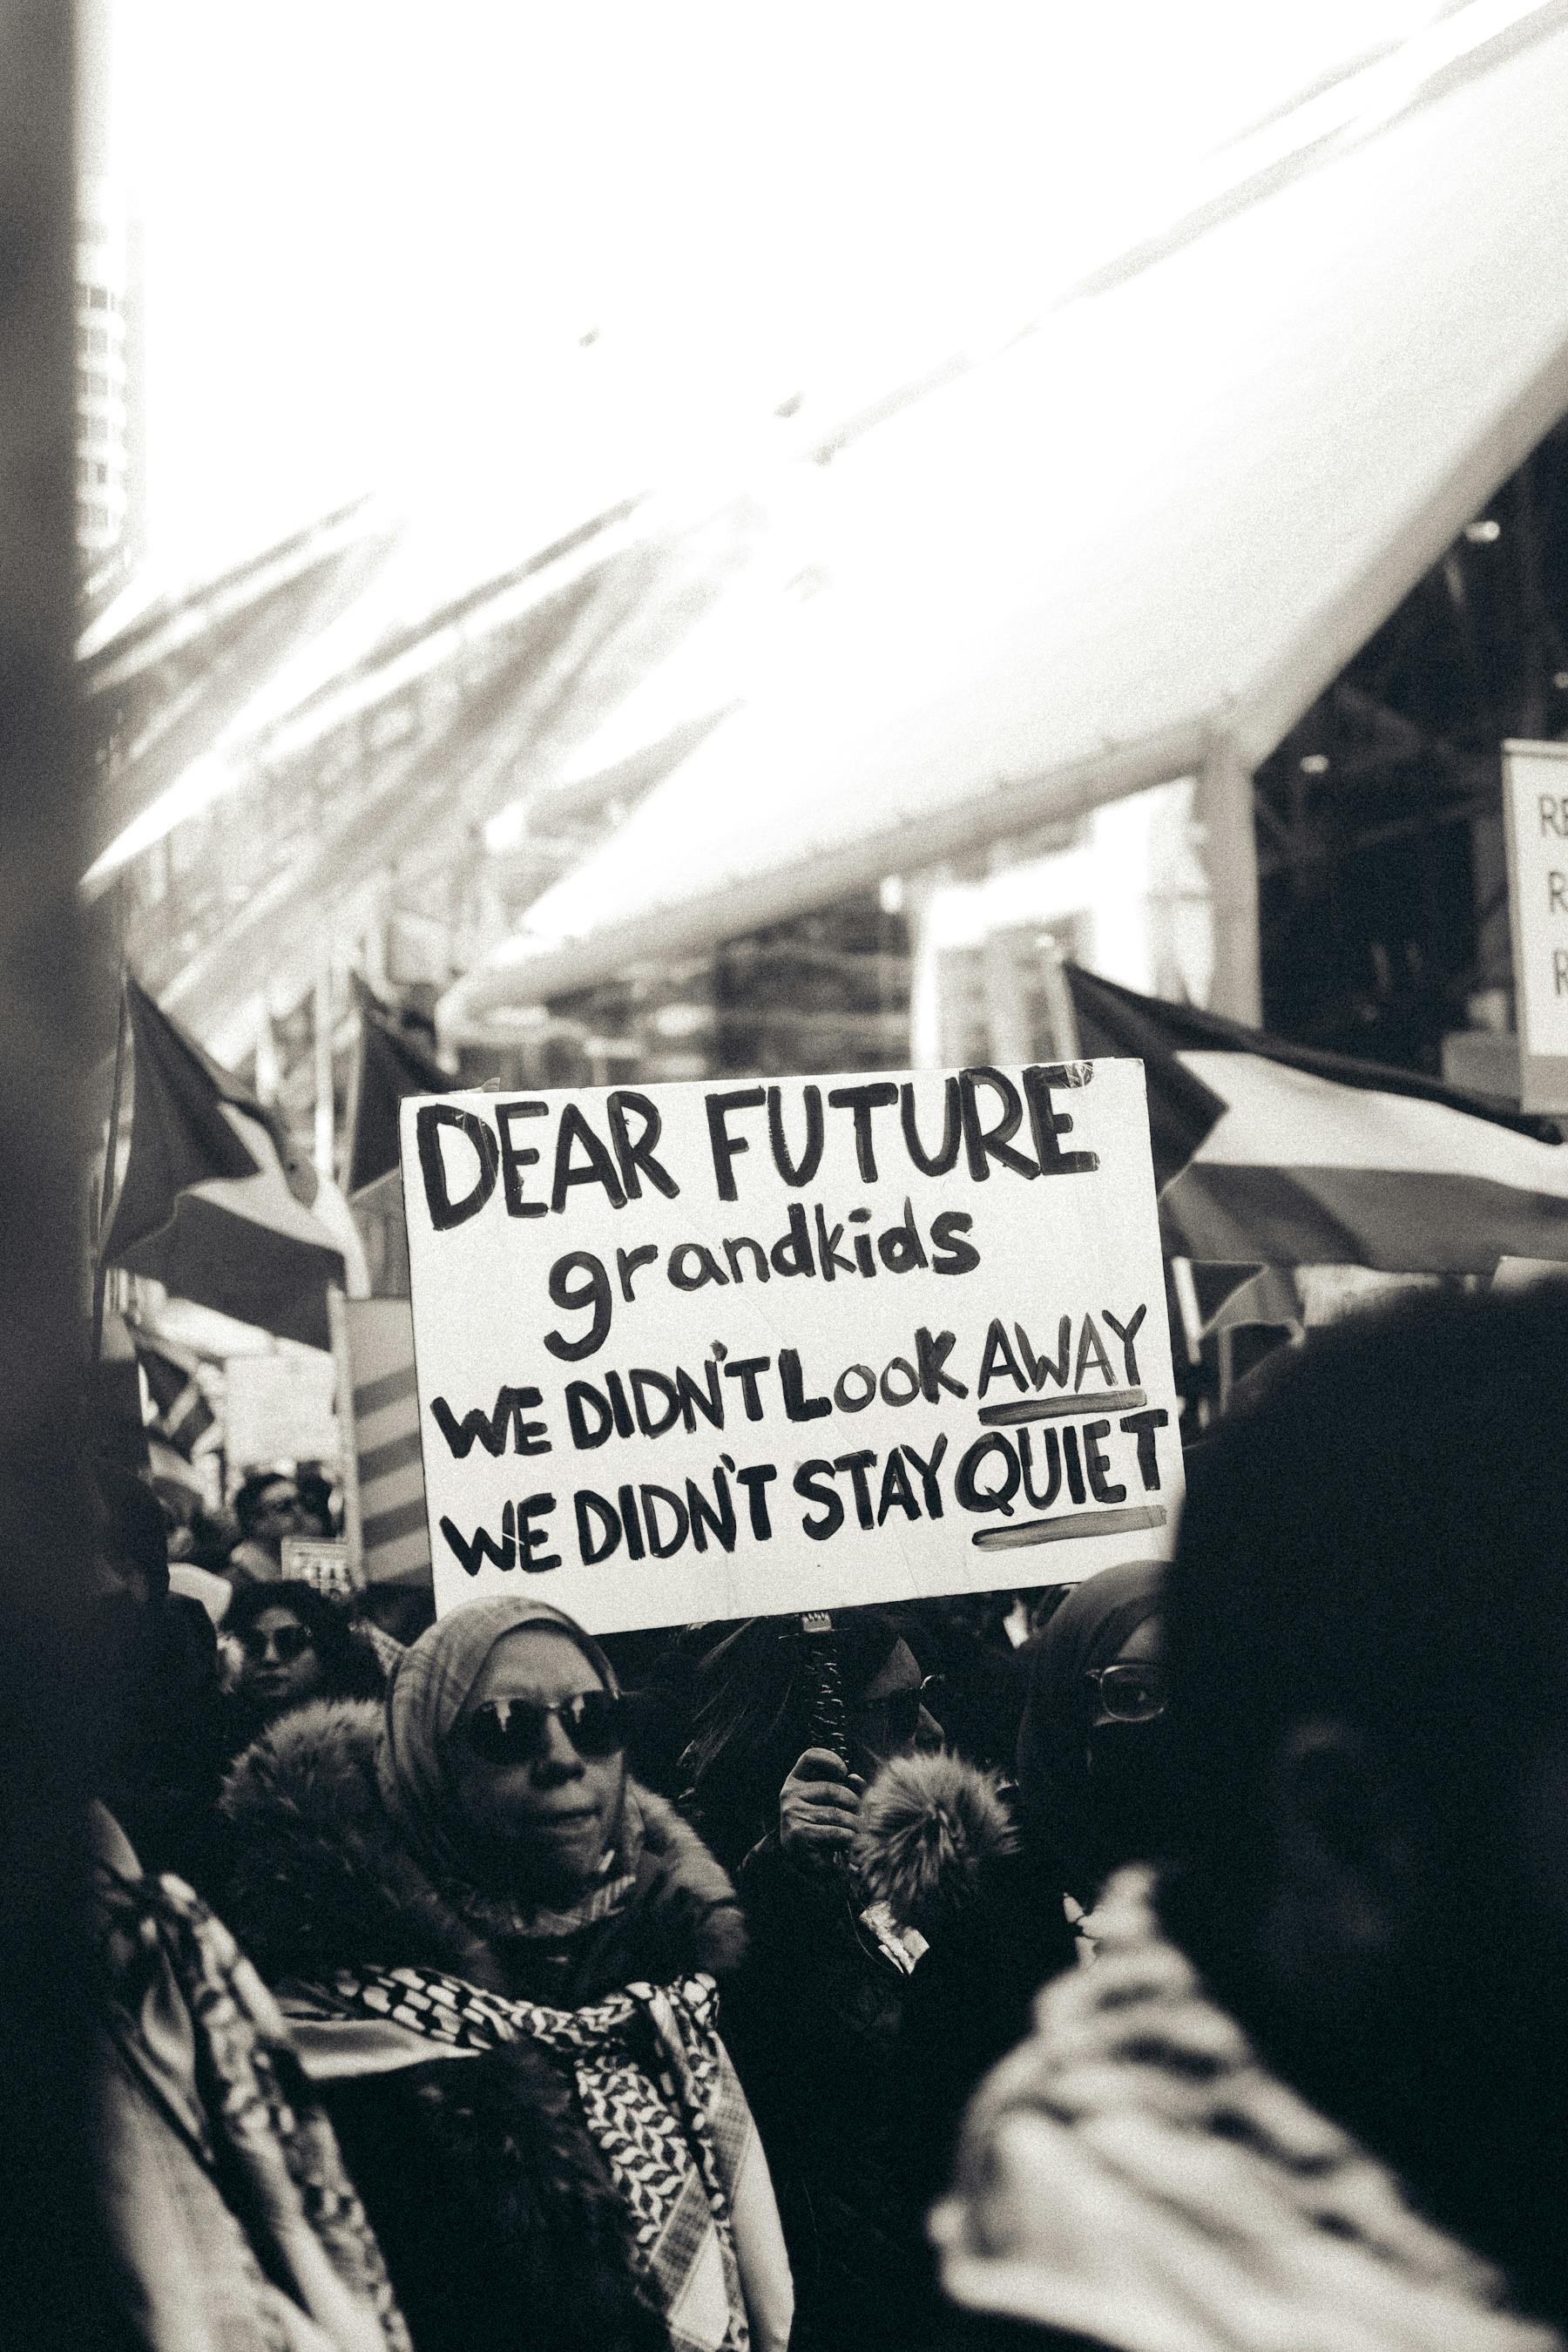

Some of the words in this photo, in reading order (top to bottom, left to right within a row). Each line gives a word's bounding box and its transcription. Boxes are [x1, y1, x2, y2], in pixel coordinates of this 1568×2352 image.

[416, 1091, 680, 1230] DEAR
[705, 1065, 1100, 1201] FUTURE
[544, 1197, 981, 1362] grandkids
[430, 1385, 552, 1458] WE
[565, 1341, 771, 1450] DIDN'T
[977, 1304, 1147, 1399] AWAY
[440, 1492, 562, 1577] WE
[574, 1452, 778, 1566] DIDN'T
[793, 1432, 950, 1541] STAY
[954, 1408, 1169, 1517] QUIET
